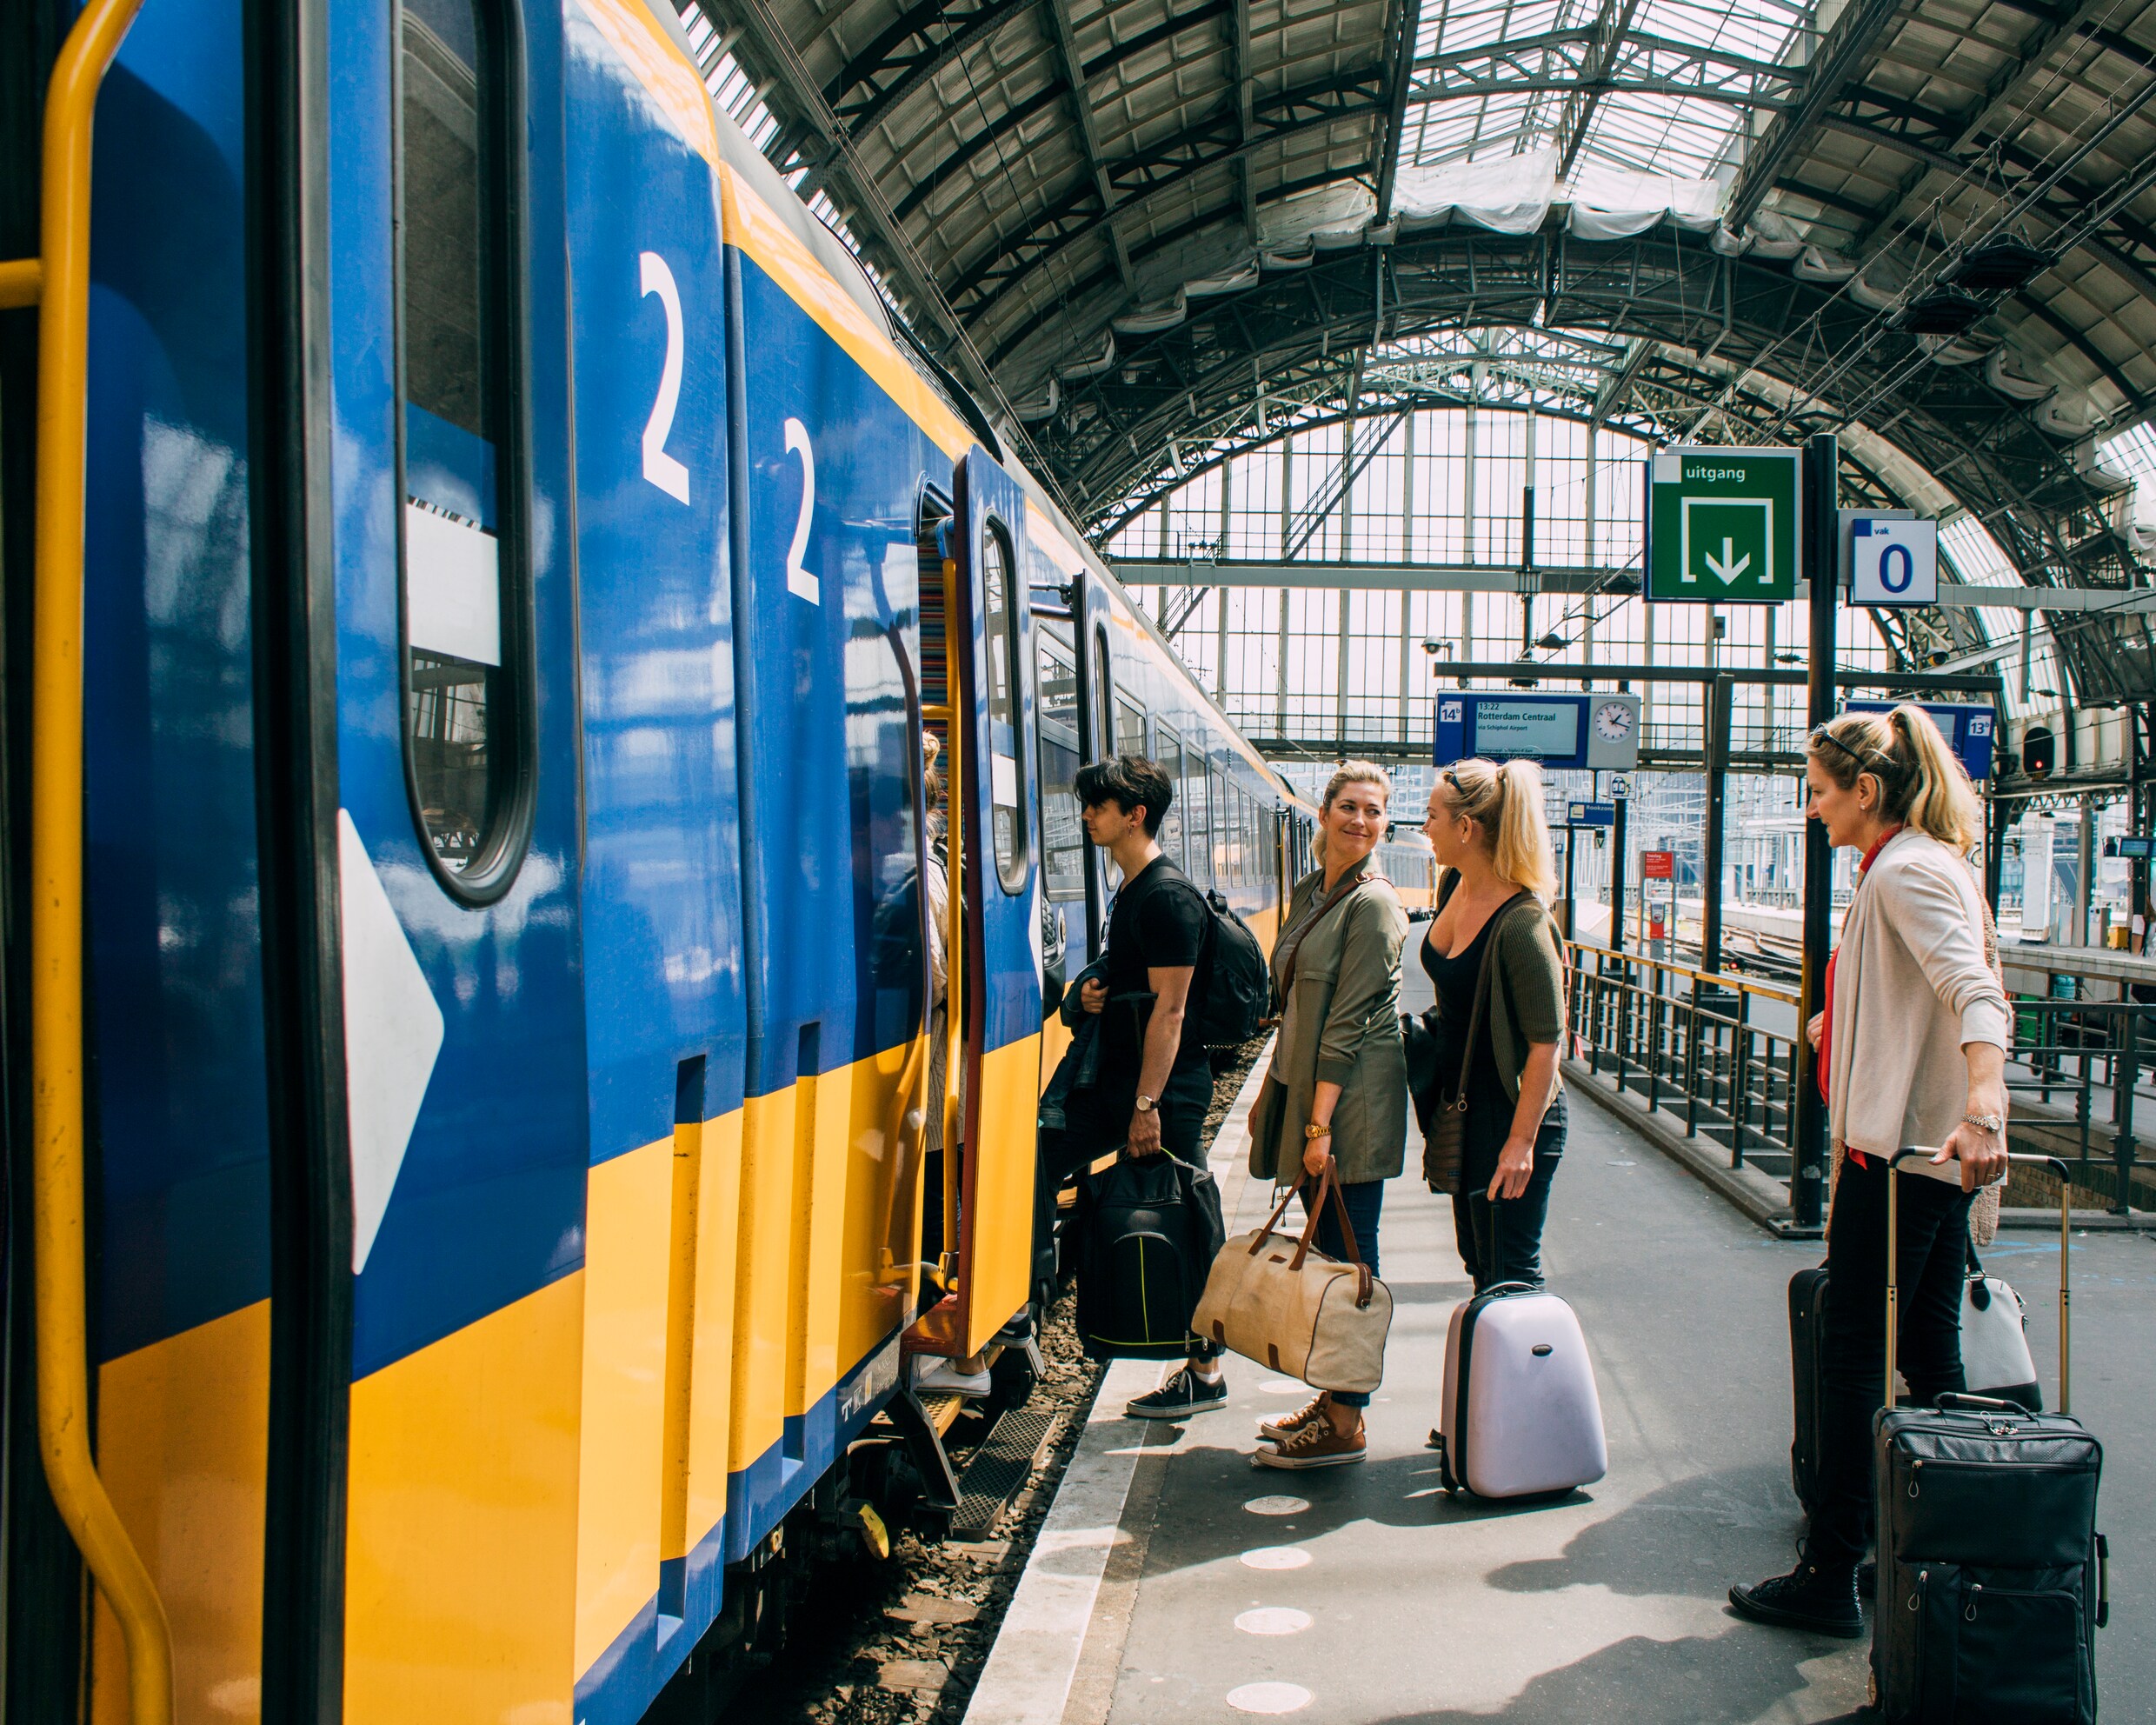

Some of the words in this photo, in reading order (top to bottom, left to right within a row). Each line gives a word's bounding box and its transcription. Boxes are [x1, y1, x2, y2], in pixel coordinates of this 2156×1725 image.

[639, 251, 690, 506] 2
[1687, 465, 1746, 483] uitgang
[784, 417, 820, 606] 2
[1879, 543, 1913, 593] 0
[1478, 712, 1520, 721] Rotterdam
